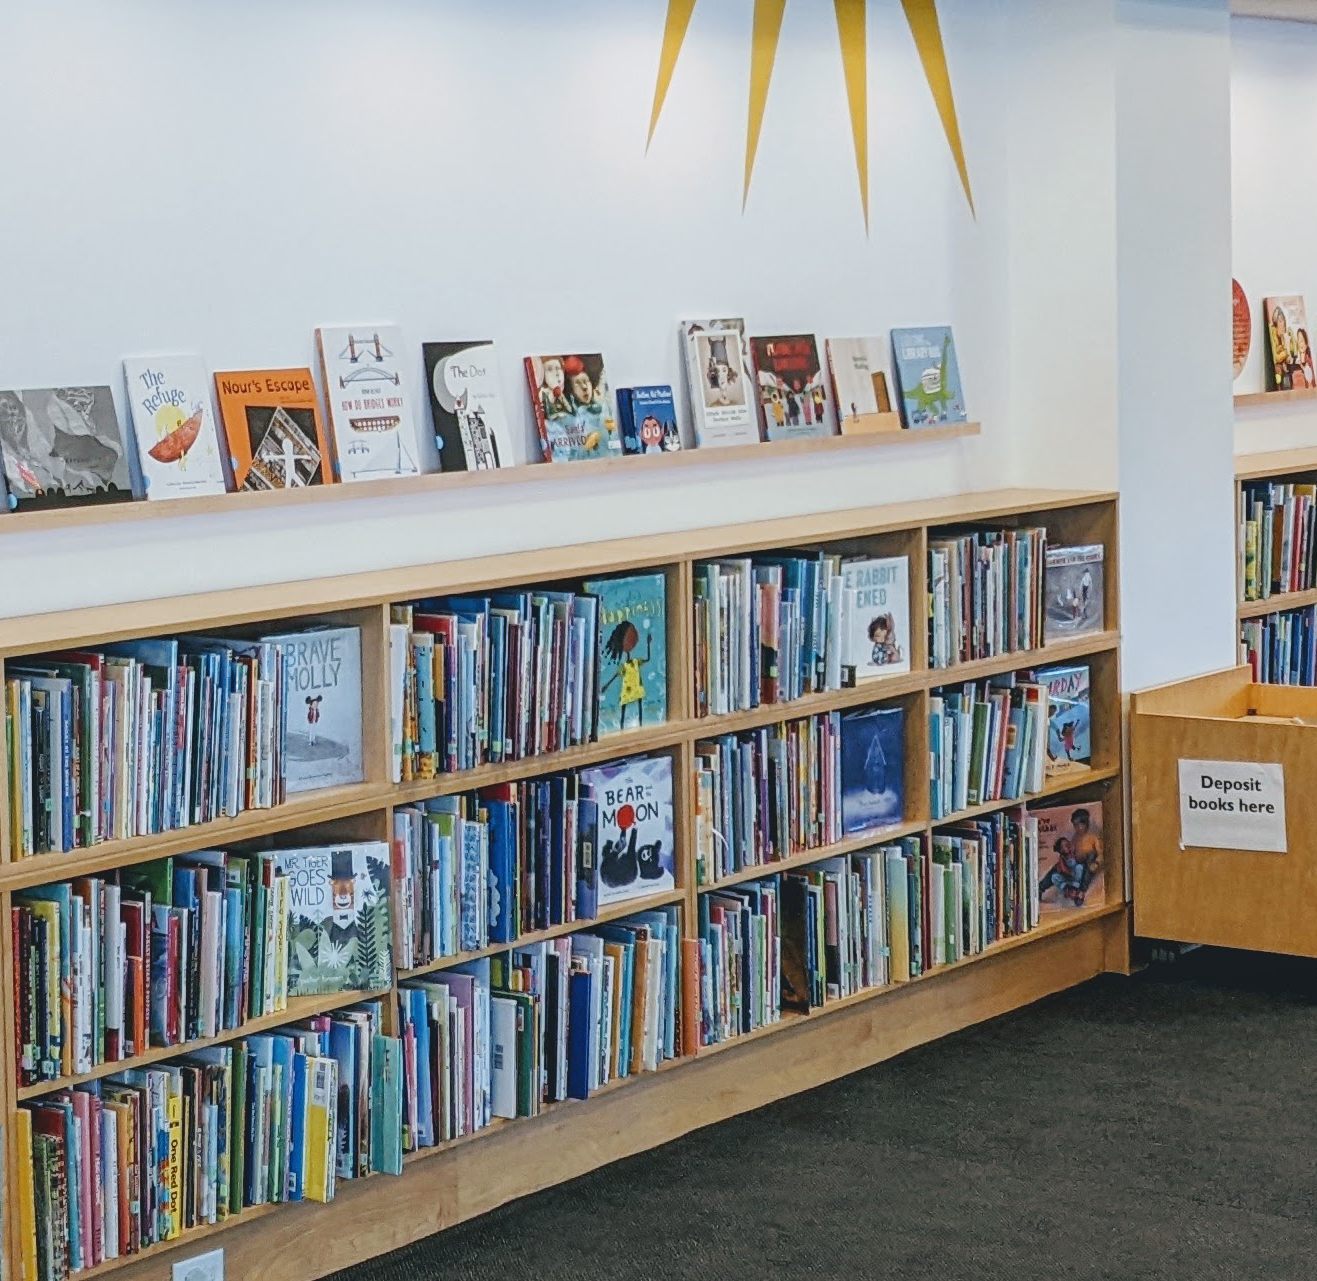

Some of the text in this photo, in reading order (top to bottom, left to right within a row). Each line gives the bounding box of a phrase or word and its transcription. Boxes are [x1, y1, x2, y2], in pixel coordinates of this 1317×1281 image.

[140, 368, 166, 390] The
[450, 365, 469, 379] The
[222, 378, 311, 395] Nour's Escape
[141, 387, 187, 416] Refuge
[285, 637, 341, 668] BRAVE
[1200, 774, 1262, 794] Deposit
[605, 785, 645, 806] BEAR
[1188, 795, 1275, 814] books here
[302, 855, 329, 868] TIGER
[289, 868, 326, 887] GOES
[290, 886, 325, 907] WILD
[170, 1139, 179, 1213] One Red Dot
